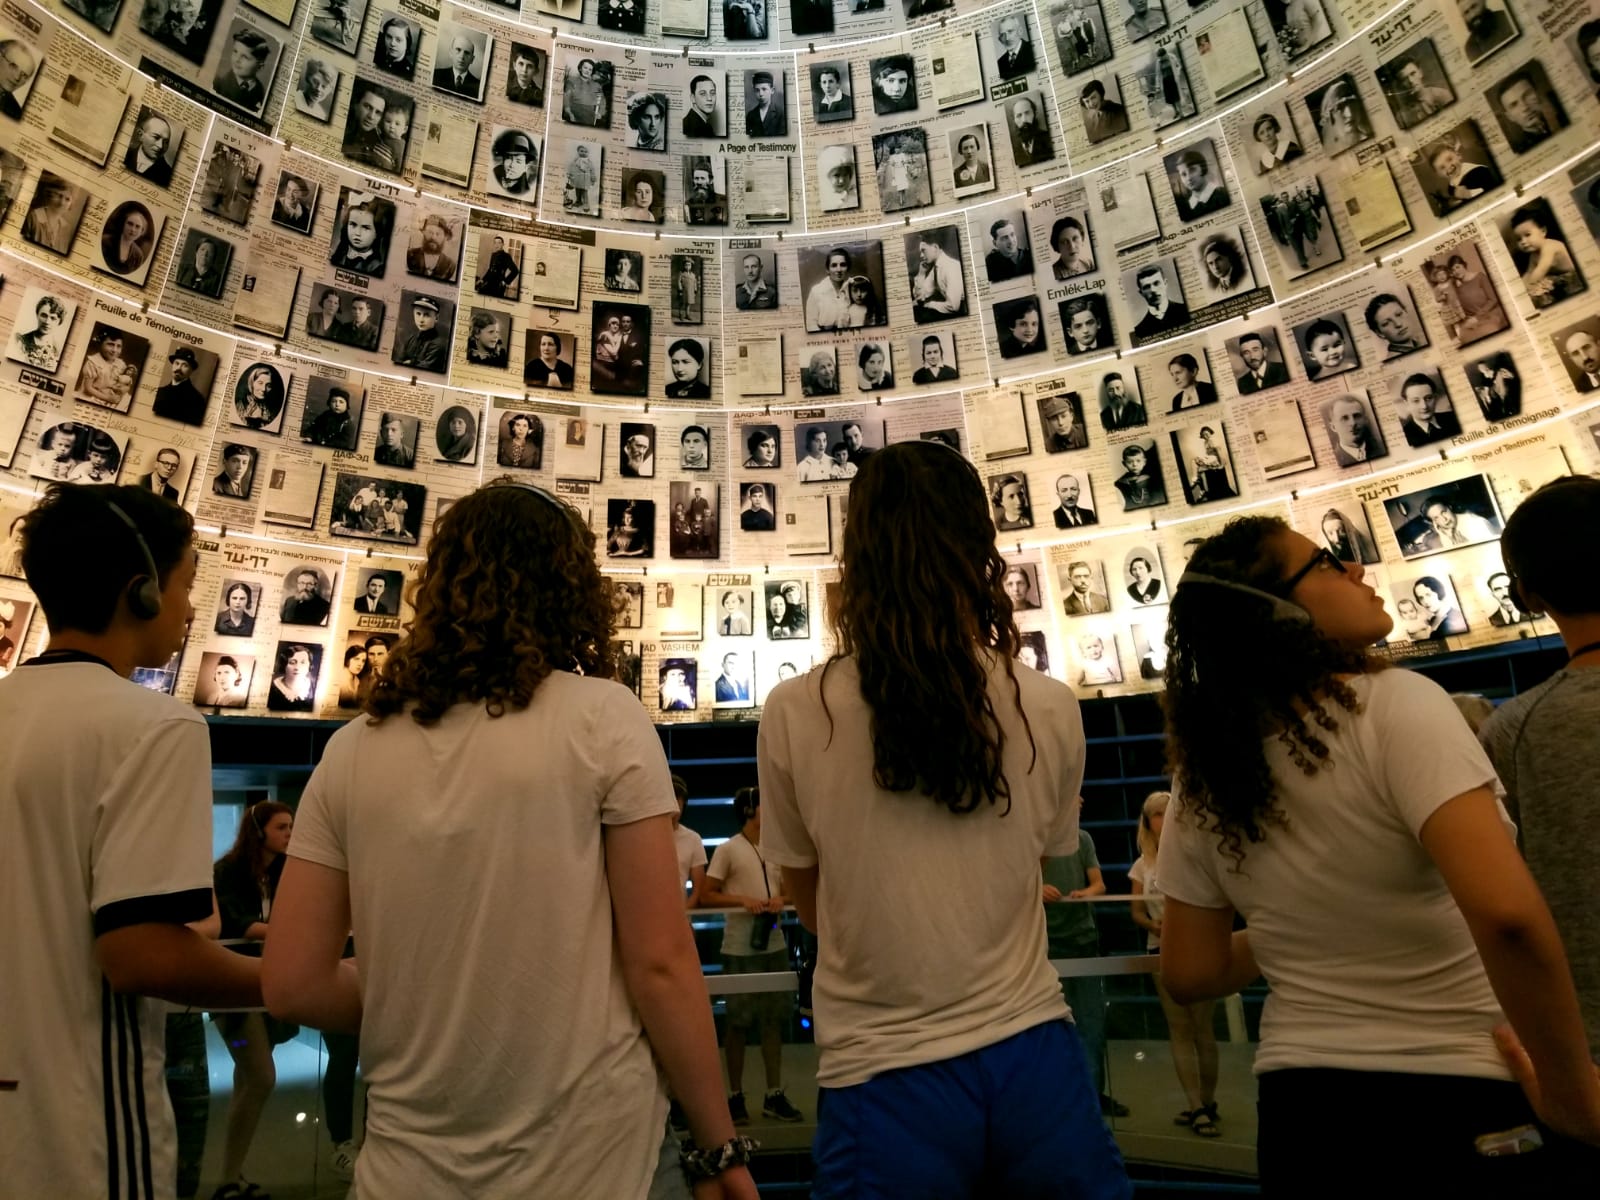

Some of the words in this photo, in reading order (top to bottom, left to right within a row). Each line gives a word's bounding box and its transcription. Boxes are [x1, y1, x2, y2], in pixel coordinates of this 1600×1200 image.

[719, 143, 725, 153] A
[727, 143, 747, 154] Page
[748, 142, 756, 152] of
[757, 142, 797, 153] Testimony
[1047, 279, 1106, 300] Emlék-Lap
[95, 299, 128, 318] Feuille
[129, 312, 142, 323] de
[144, 317, 204, 345] Témoignage
[1451, 431, 1485, 446] Feuille
[1486, 425, 1499, 435] de
[1472, 451, 1493, 463] Page
[1494, 446, 1502, 455] of
[1503, 434, 1546, 451] Testimony
[1358, 484, 1400, 502] דף-עד
[223, 551, 270, 568] דף-עד
[710, 575, 732, 586] ושם
[735, 575, 749, 585] יד
[661, 643, 700, 652] VASHEM
